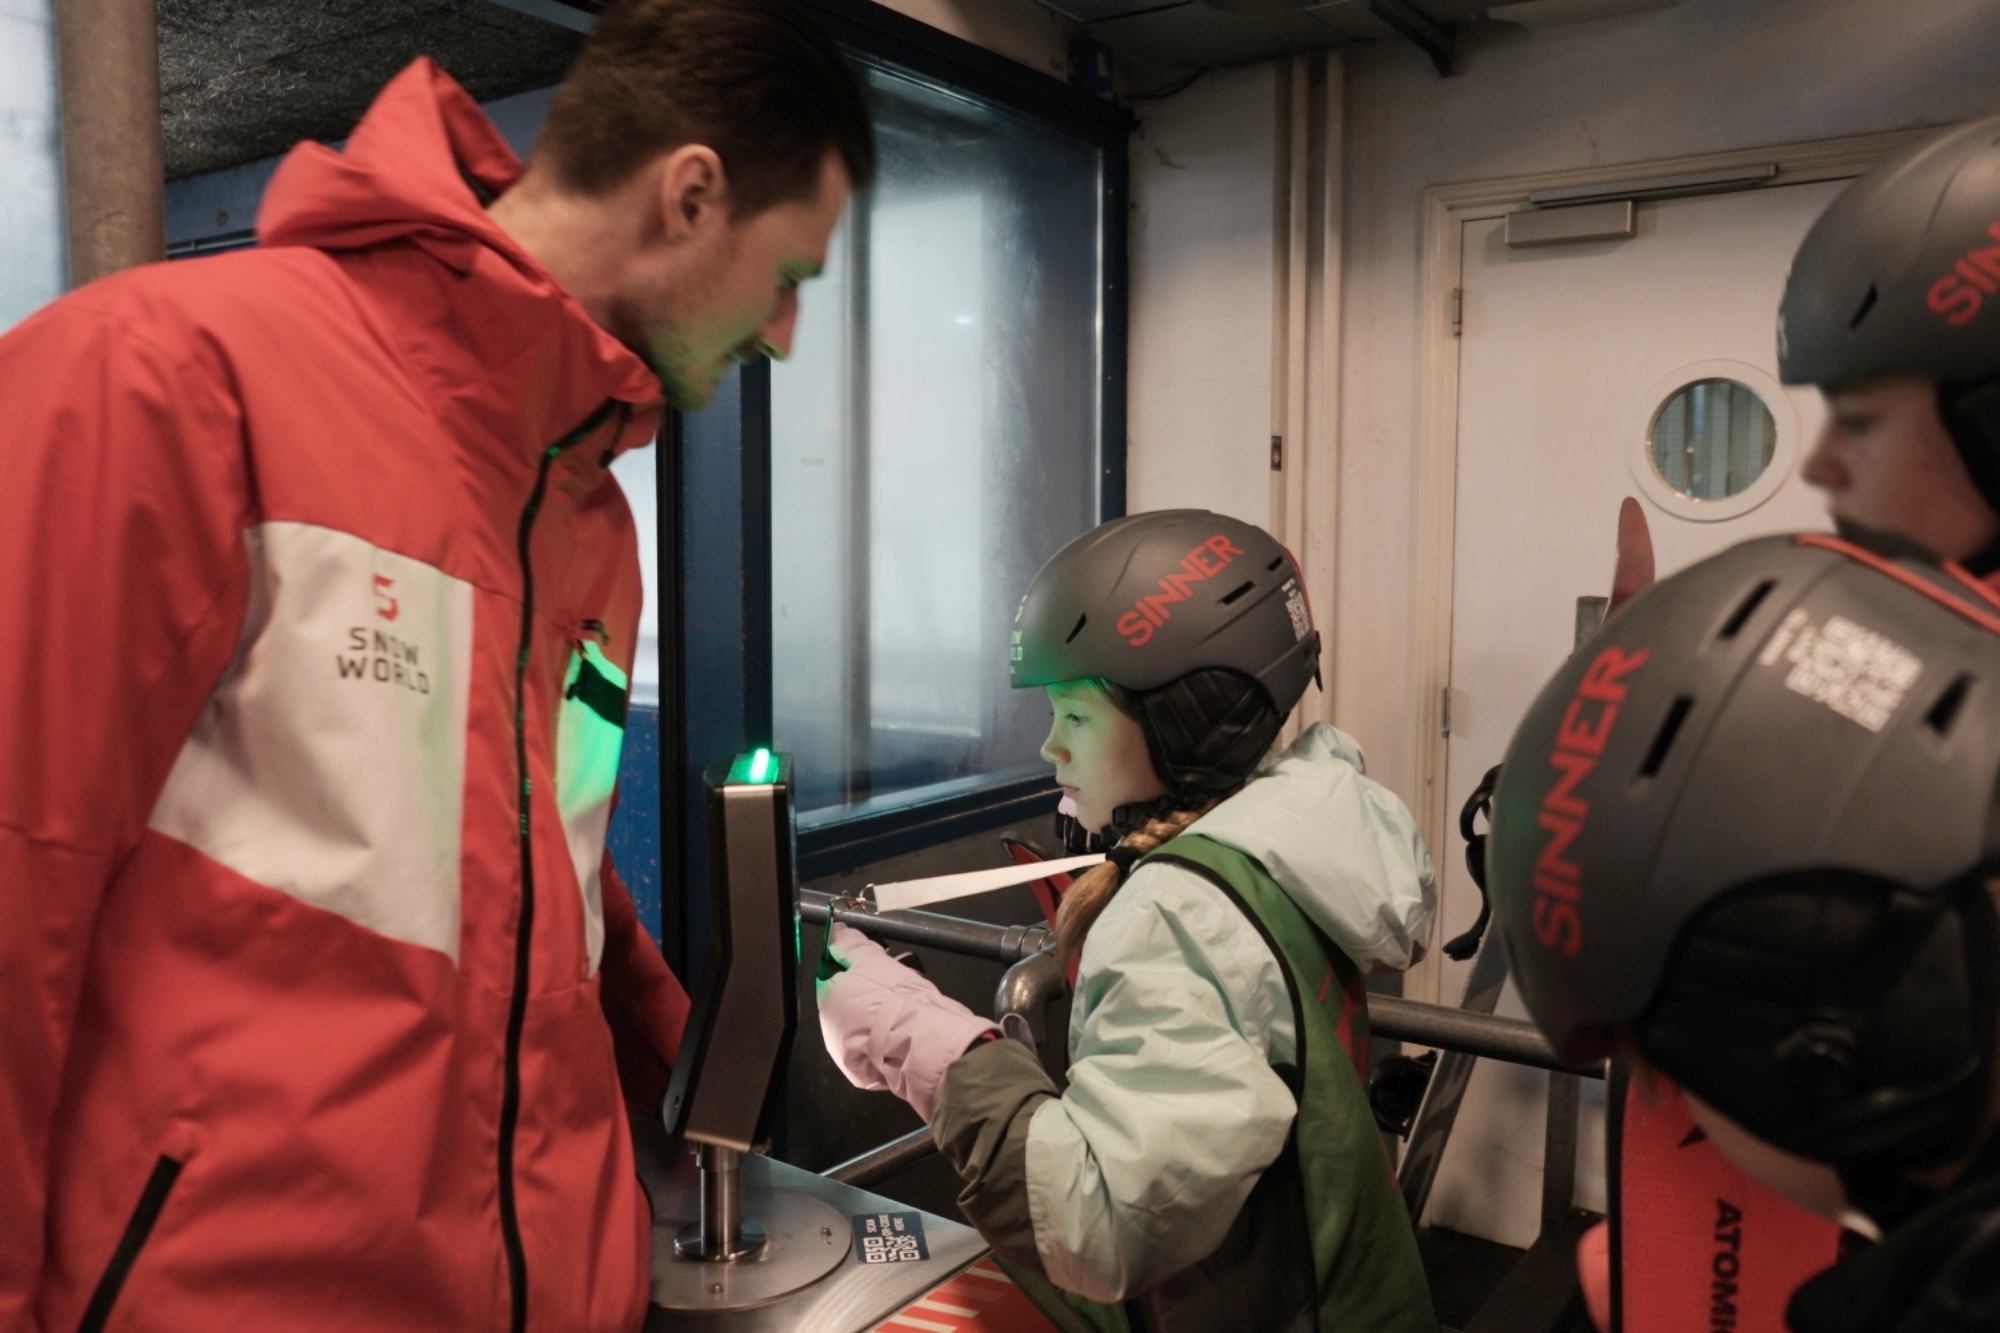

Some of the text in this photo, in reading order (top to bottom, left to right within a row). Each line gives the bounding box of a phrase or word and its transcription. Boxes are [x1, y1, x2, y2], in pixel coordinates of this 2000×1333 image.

[1116, 534, 1244, 647] SINNER
[349, 626, 418, 667] SNOW
[336, 654, 430, 695] WORLD
[1532, 645, 1650, 957] SINNER
[865, 1218, 877, 1233] SCAN
[893, 1217, 905, 1231] HERE
[1709, 1197, 1742, 1333] ATOMI
